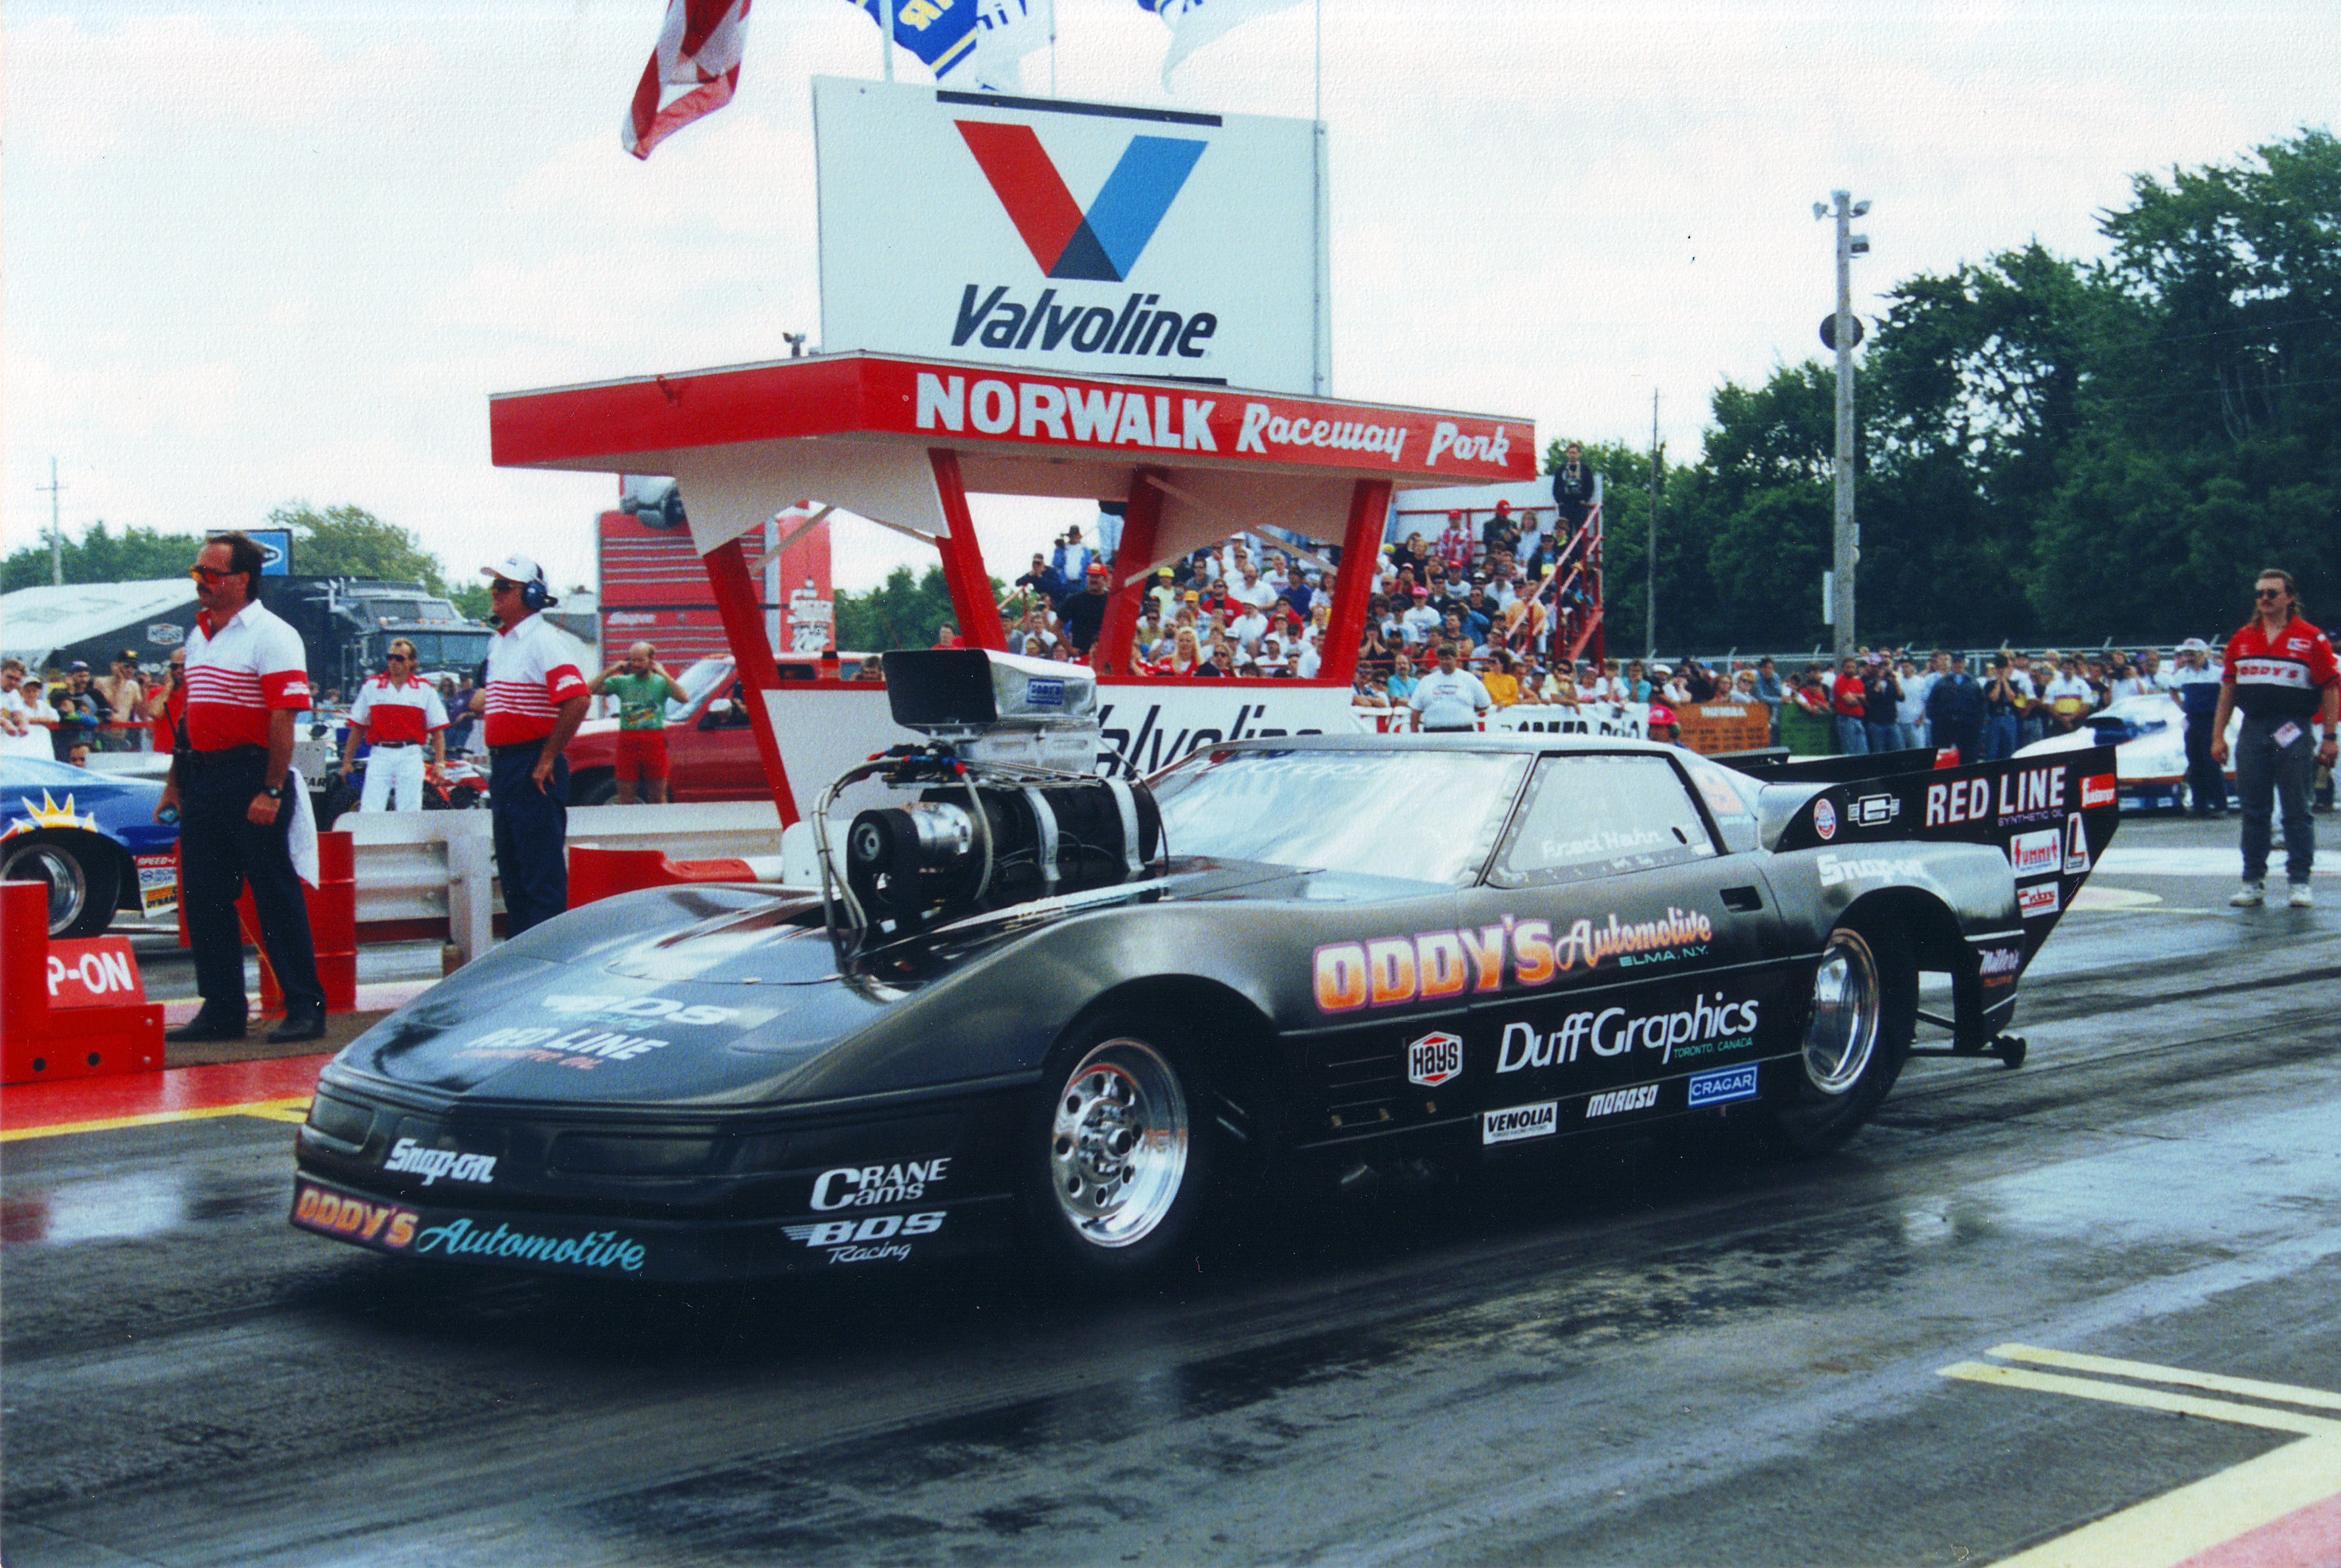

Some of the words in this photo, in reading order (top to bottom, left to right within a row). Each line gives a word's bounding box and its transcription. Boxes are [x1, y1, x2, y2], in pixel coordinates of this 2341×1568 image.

[950, 283, 1218, 358] Valvoline
[915, 373, 1218, 452] NORWALK
[1236, 403, 1407, 462] Raceway
[1426, 421, 1510, 467] Park
[1926, 777, 1989, 827] RED
[1998, 765, 2066, 815] LINE
[1313, 913, 1556, 1014] ODDY'S
[1555, 906, 1713, 970] Automotive
[543, 1029, 670, 1060] LINE
[1496, 991, 1759, 1074] DuffGraphics
[1717, 1036, 1753, 1051] CANADA
[1585, 1084, 1659, 1118] MOROSO
[1691, 1074, 1752, 1097] CRAGAR
[1487, 1107, 1553, 1133] VENOLIA
[384, 1137, 498, 1186] Snap-on
[809, 1157, 952, 1211] CRANE
[295, 1185, 420, 1248] ODDY'S
[416, 1218, 646, 1271] Automotive
[806, 1210, 948, 1247] BDS
[826, 1241, 912, 1265] Racing
